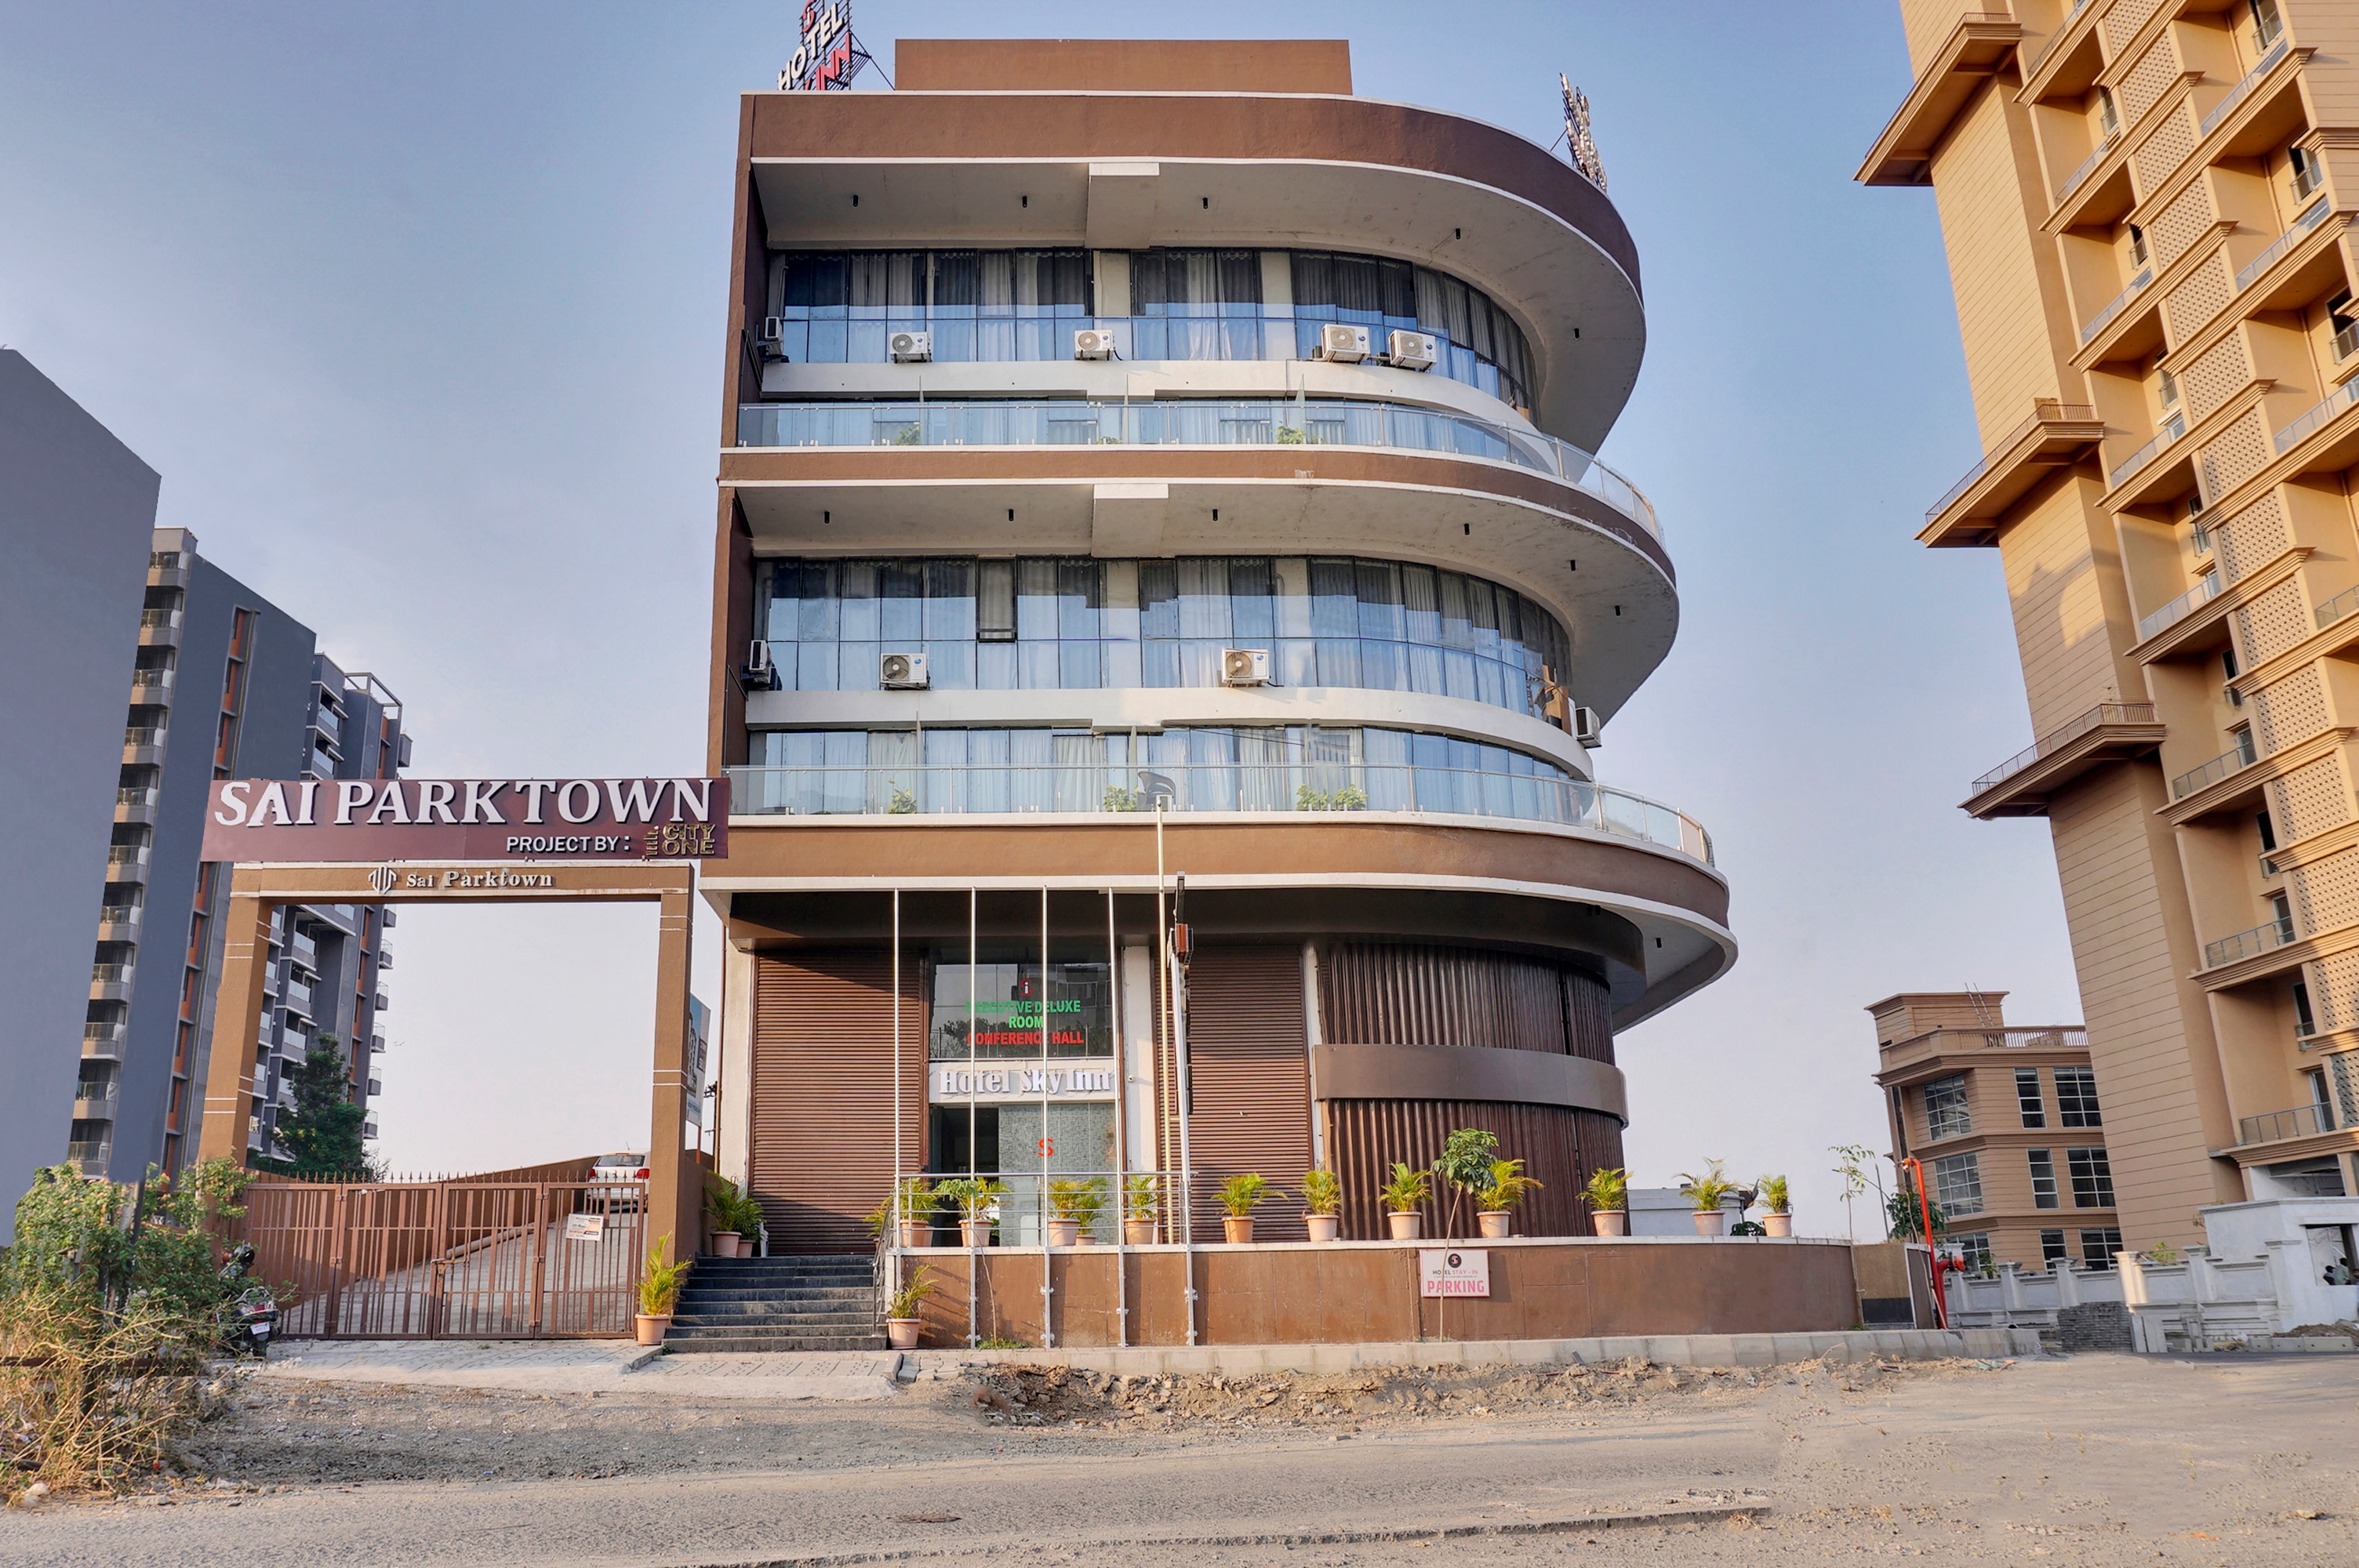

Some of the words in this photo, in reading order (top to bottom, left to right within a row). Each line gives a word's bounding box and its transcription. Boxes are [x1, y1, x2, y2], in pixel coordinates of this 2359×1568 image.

[778, 2, 842, 90] HOTEL
[214, 781, 318, 827] SAI
[662, 824, 715, 840] CITY
[506, 836, 591, 852] PROJECT
[662, 839, 715, 855] ONE
[405, 873, 434, 887] Sai
[445, 870, 553, 888] Parktown
[965, 1000, 1034, 1014] EXECUTIVE
[1052, 1031, 1084, 1045] HALL
[939, 1070, 1010, 1094] Hotel
[1020, 1069, 1063, 1094] Sky
[1065, 1069, 1110, 1092] Inn
[1427, 1279, 1485, 1293] PARKING
